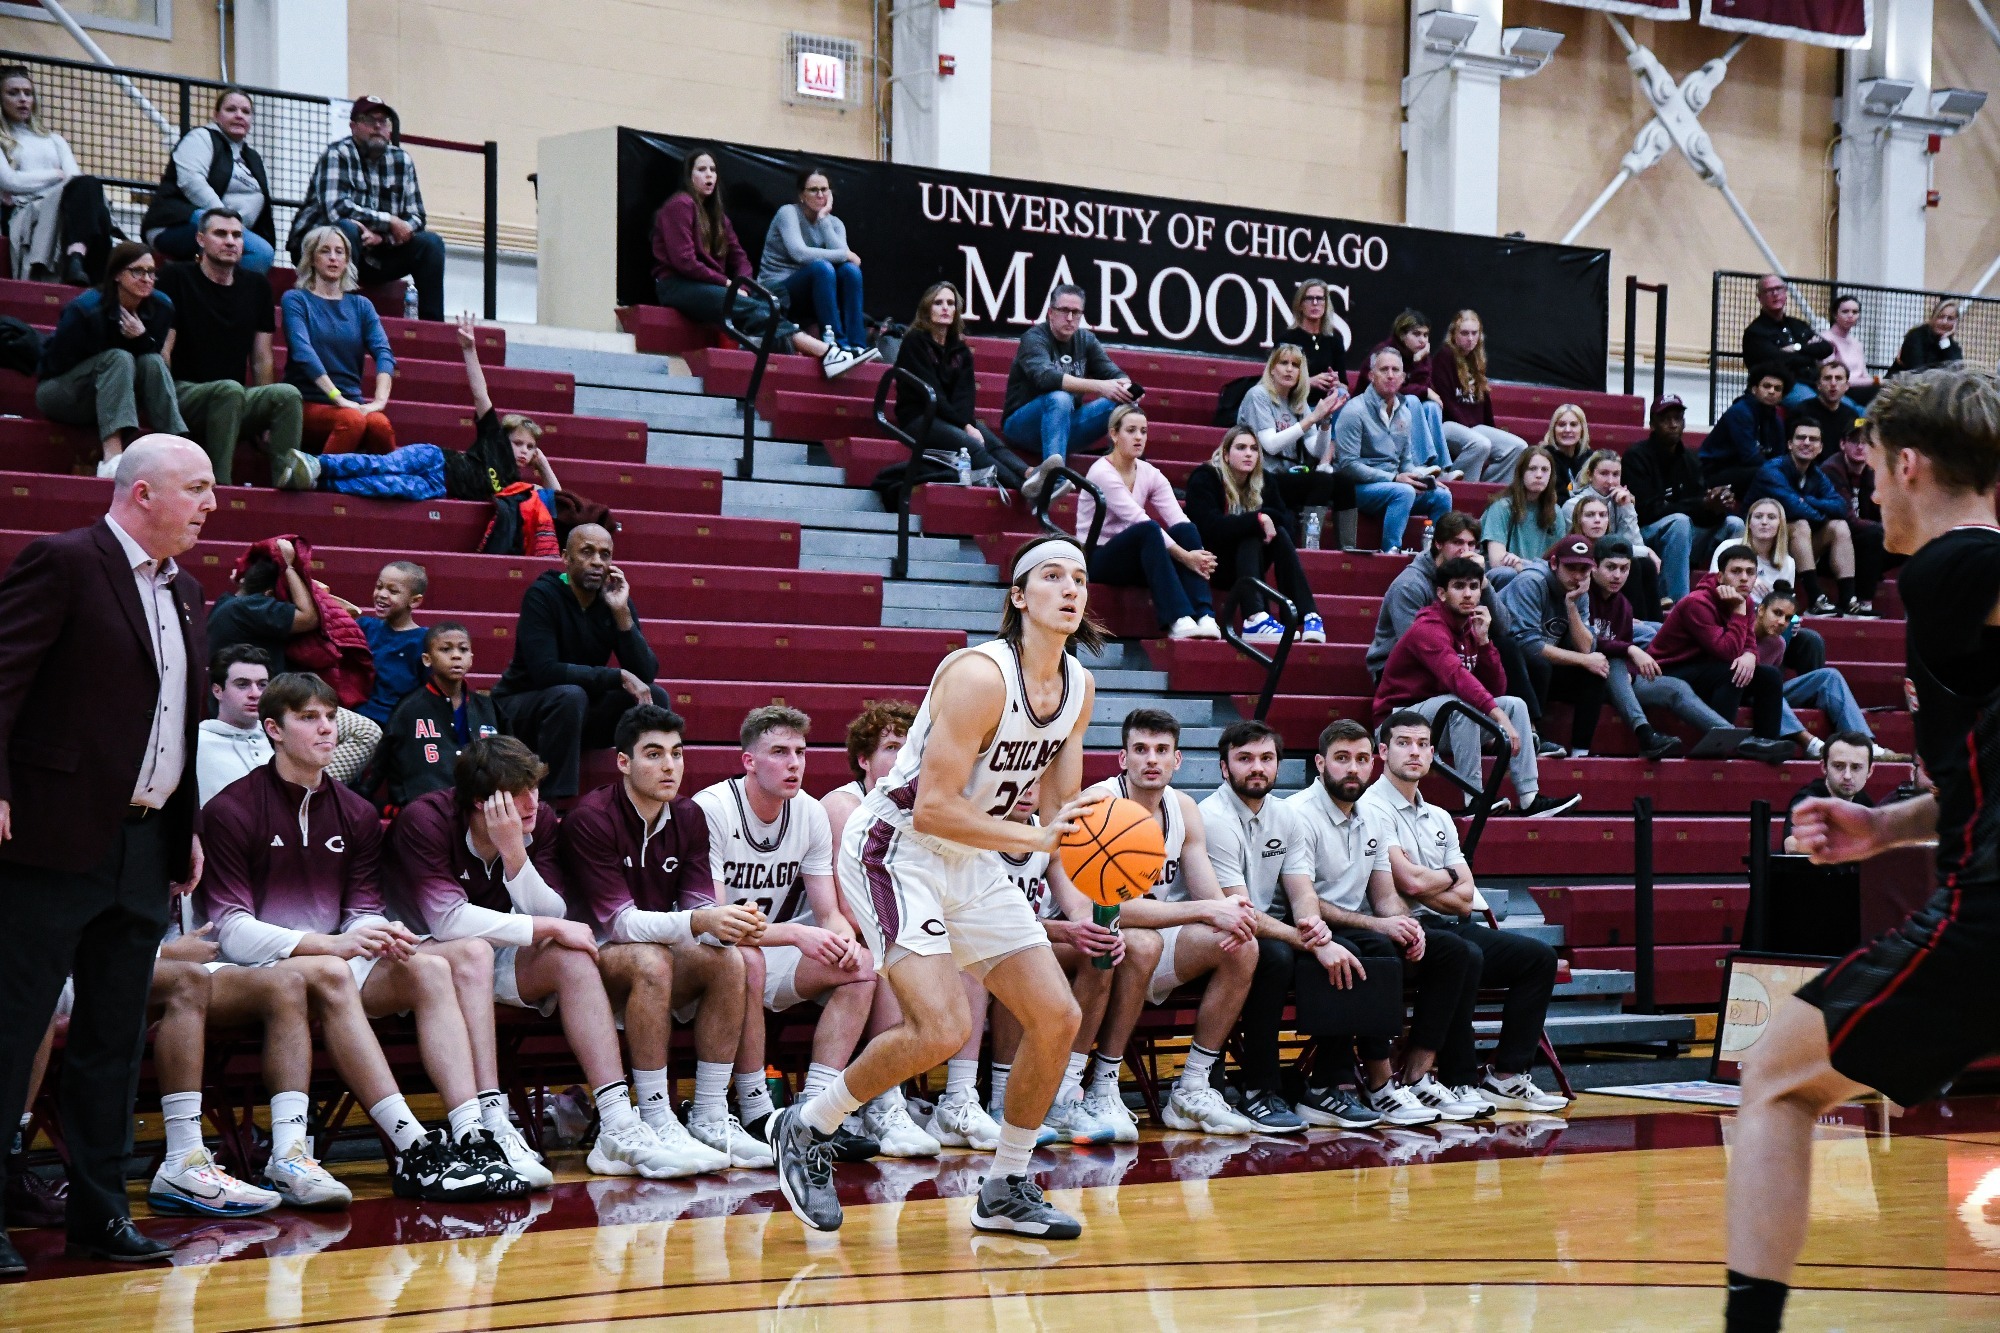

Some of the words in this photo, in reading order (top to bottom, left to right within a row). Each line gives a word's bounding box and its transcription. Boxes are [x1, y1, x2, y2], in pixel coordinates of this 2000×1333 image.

[804, 58, 837, 88] EXIT
[919, 182, 1160, 244] UNIVERSITY
[1167, 213, 1216, 251] OF
[1225, 219, 1389, 271] CHICAGO
[415, 718, 442, 739] AL
[424, 743, 440, 763] 6
